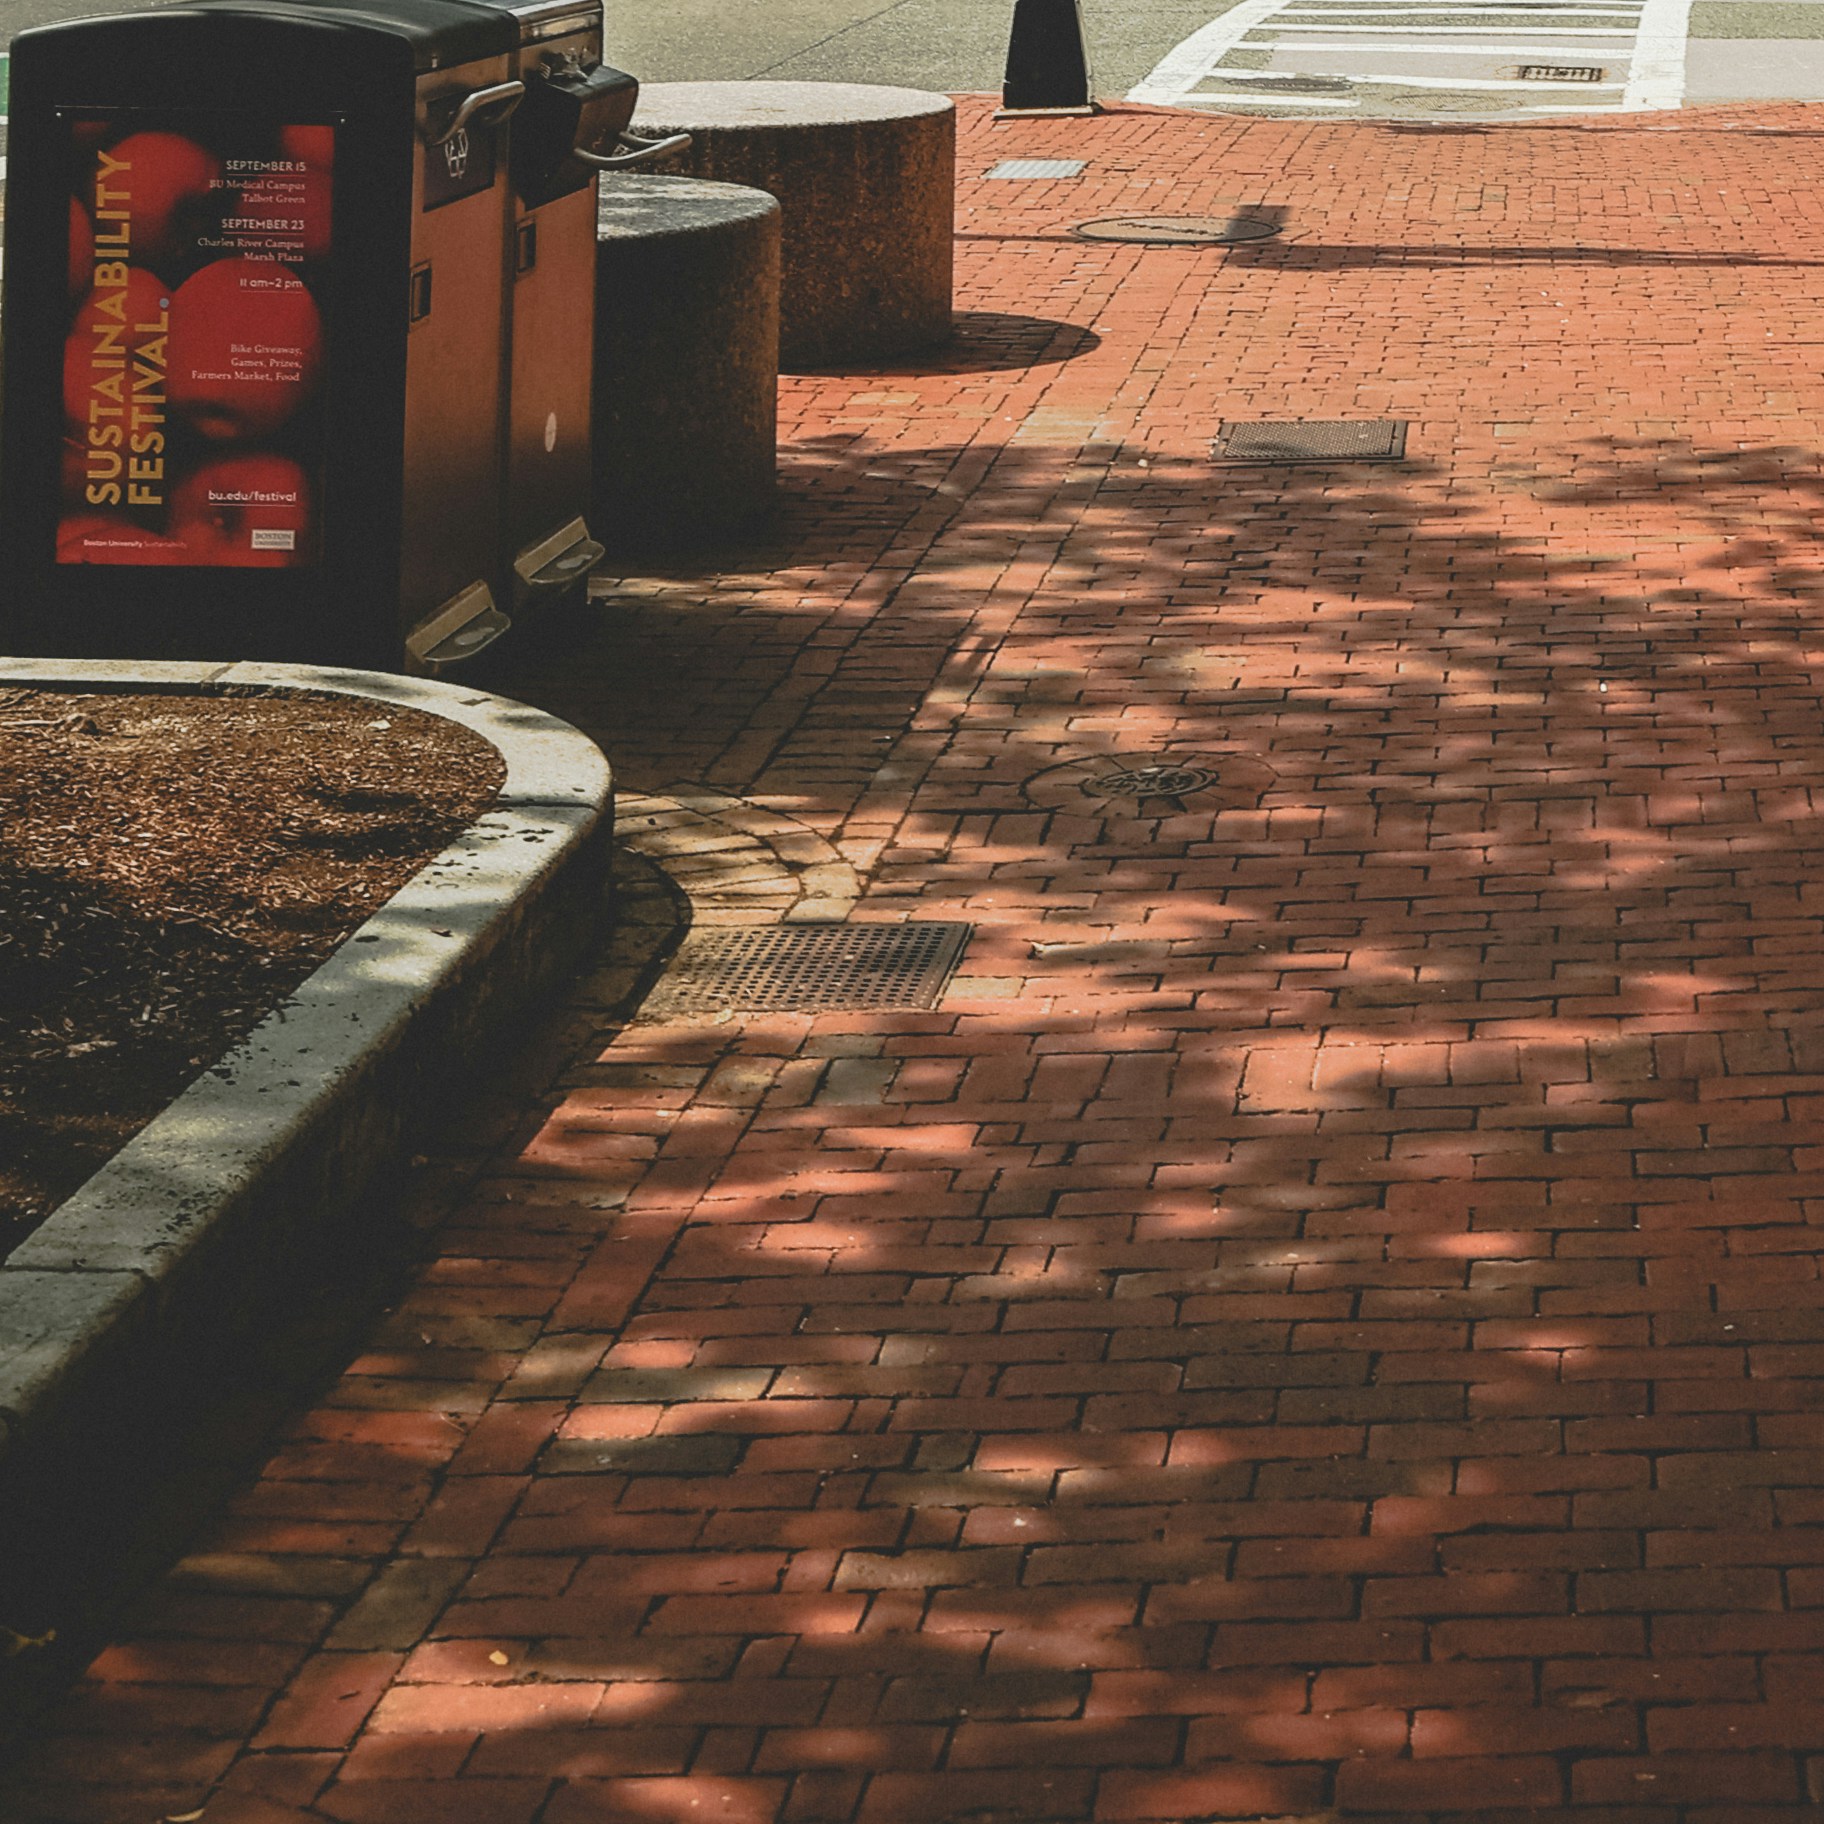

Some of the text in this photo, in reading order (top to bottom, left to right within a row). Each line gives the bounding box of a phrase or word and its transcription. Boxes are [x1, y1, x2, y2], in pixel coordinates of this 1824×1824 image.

[226, 160, 306, 172] SEPTEMBER 15
[209, 180, 306, 193] BU Medical Campus
[242, 194, 306, 204] Talbot Green
[221, 218, 305, 230] SEPTEMBER 23
[197, 238, 304, 250] Charles River Campus
[244, 252, 304, 262] Marsh Plaza
[284, 280, 302, 290] pm
[86, 150, 132, 505] SUSTAINABILITY
[230, 344, 303, 356] Bike Giveaway,
[269, 359, 302, 368] Prizes,
[192, 370, 300, 381] Farmers Market, Food
[208, 490, 296, 502] bu.edu/festival
